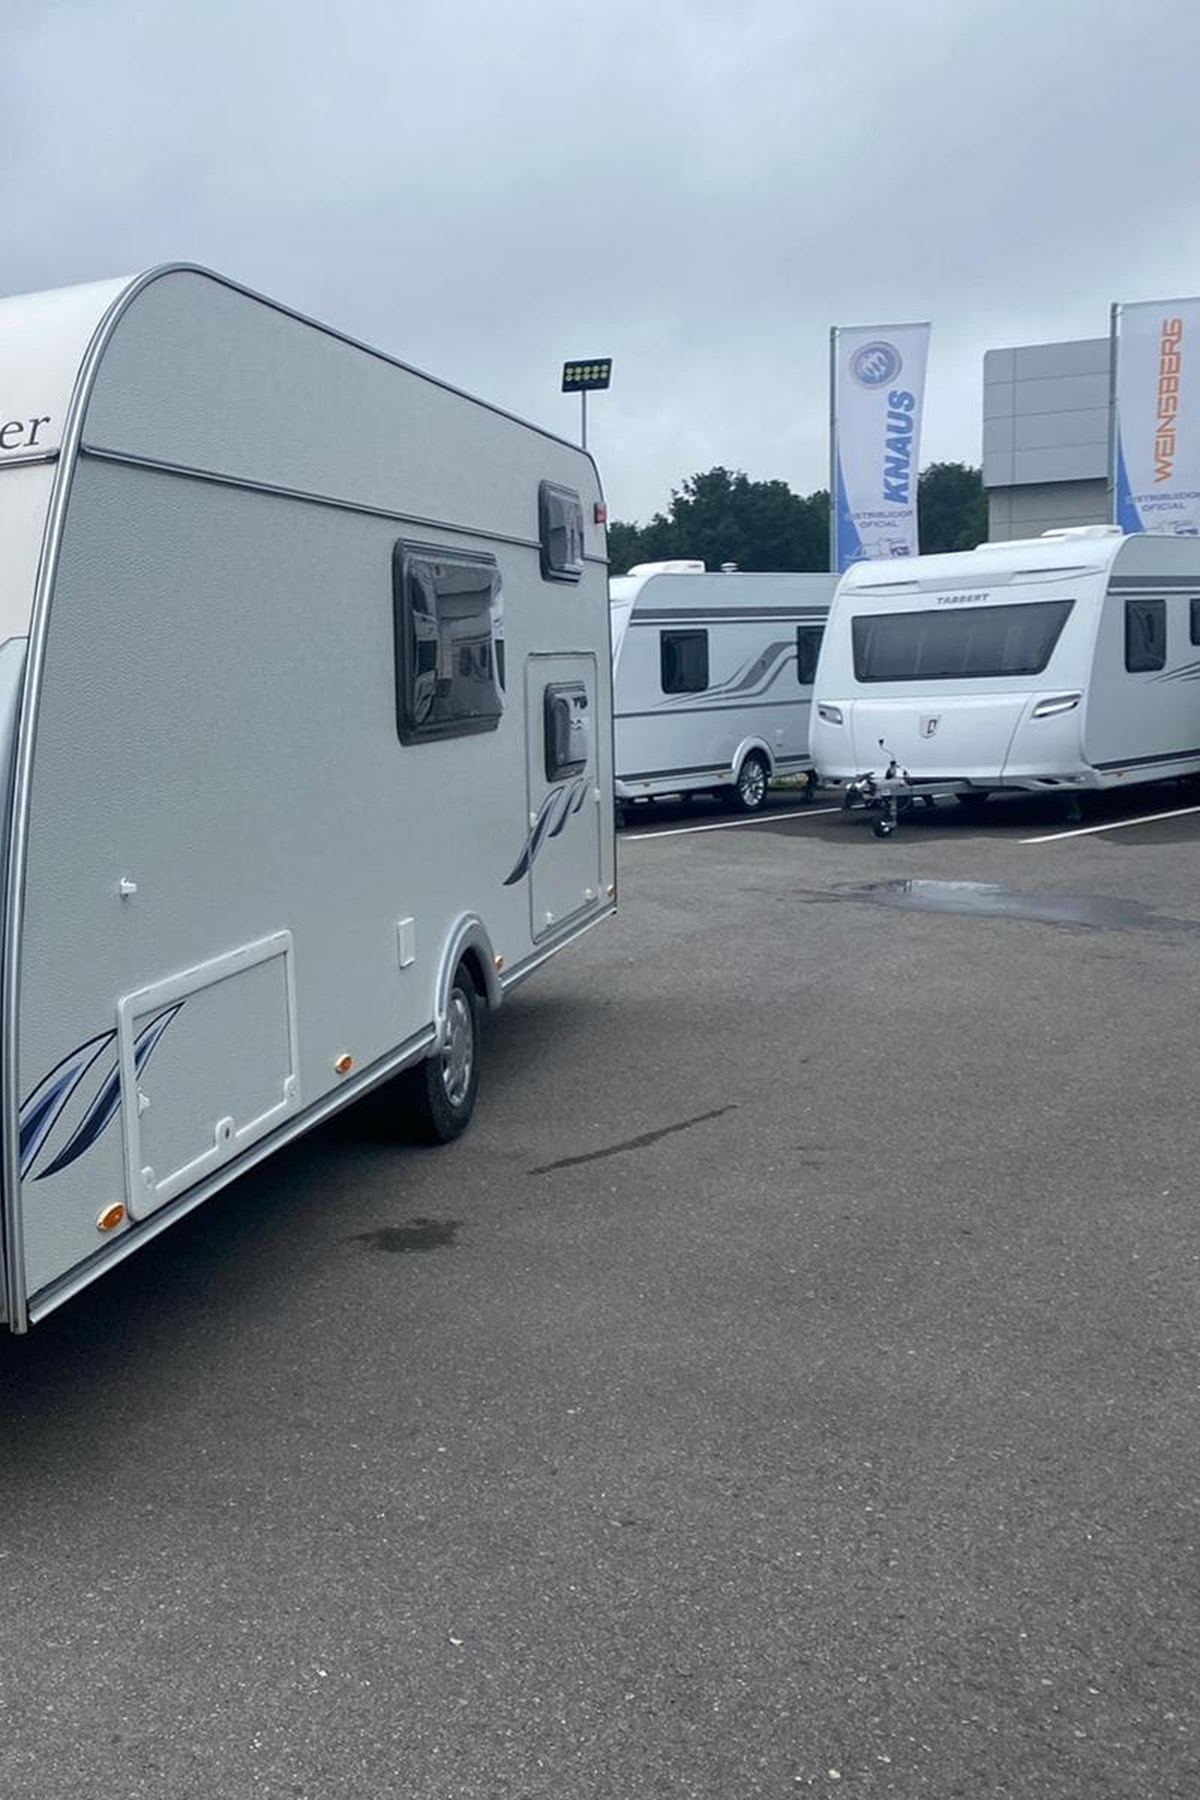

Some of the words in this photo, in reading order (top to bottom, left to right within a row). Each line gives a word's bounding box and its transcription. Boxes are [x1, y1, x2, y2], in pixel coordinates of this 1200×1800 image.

[883, 389, 915, 505] KNAUS
[1153, 317, 1183, 484] WEINSBERG
[936, 593, 991, 604] TABBERT
